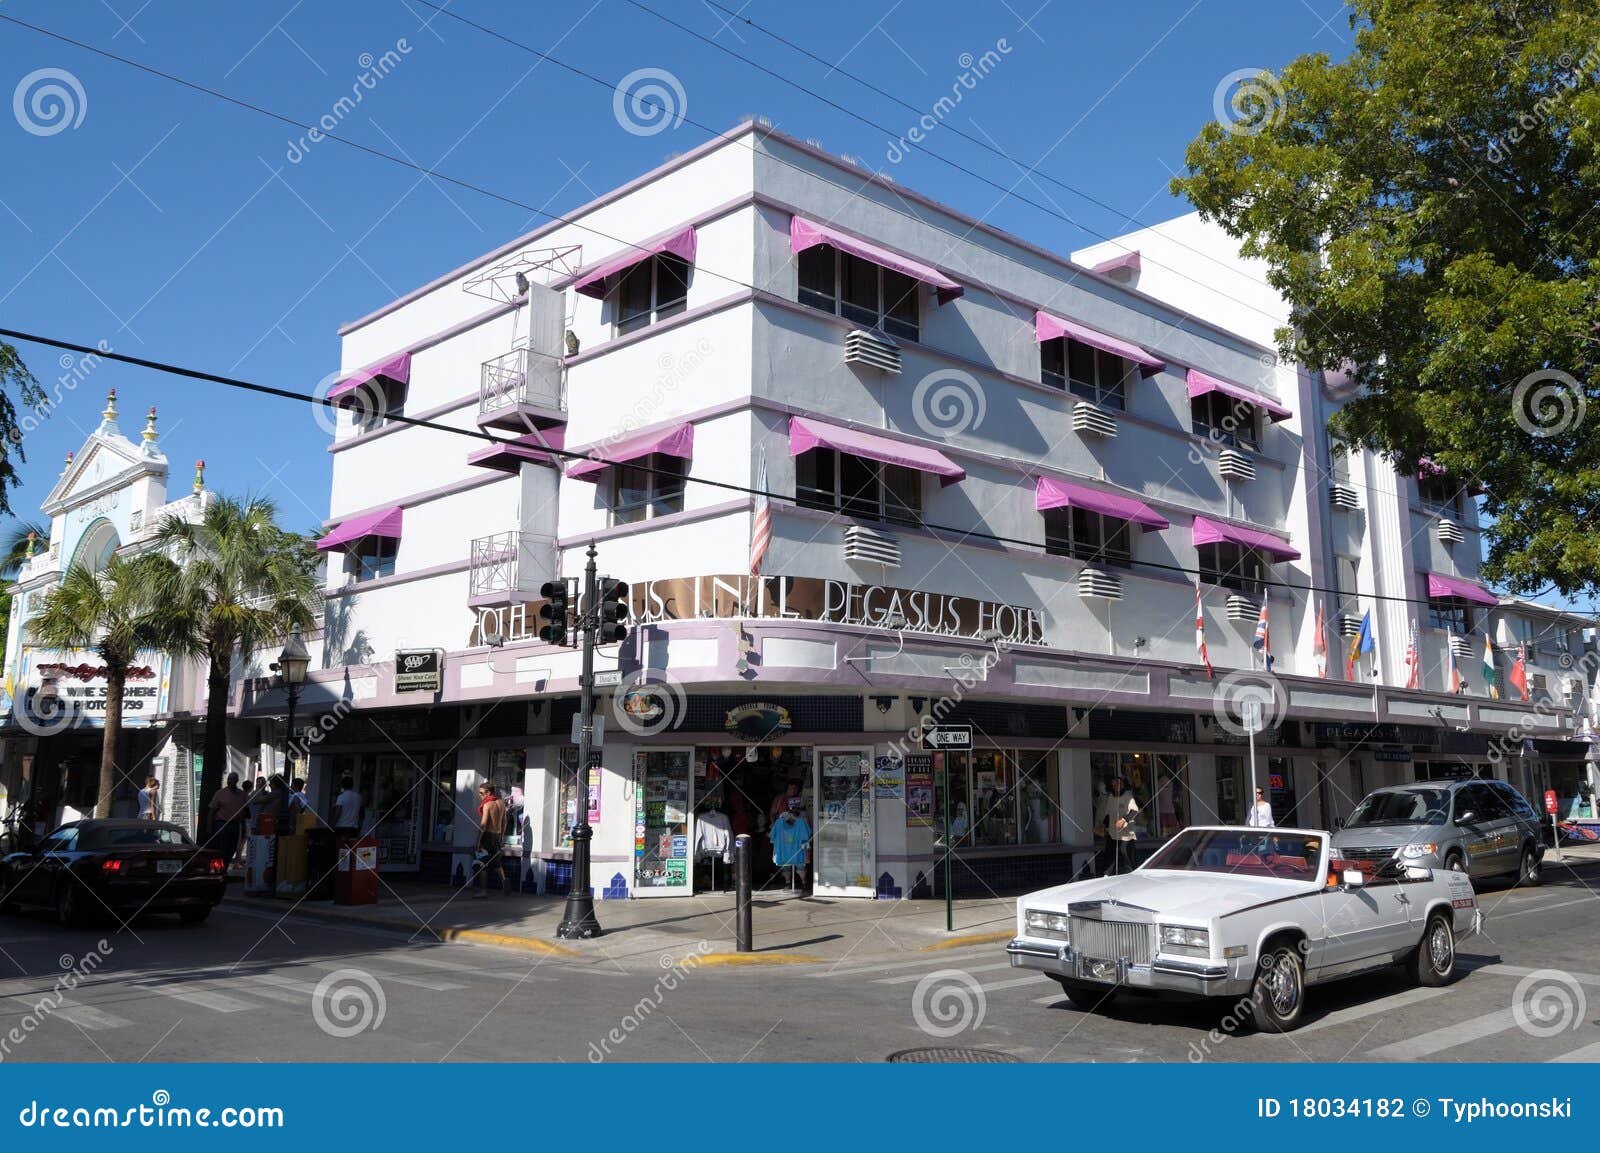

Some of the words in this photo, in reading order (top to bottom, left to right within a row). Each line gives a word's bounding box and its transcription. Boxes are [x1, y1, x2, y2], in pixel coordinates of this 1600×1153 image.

[824, 579, 961, 633] PEGASUS
[405, 655, 423, 668] AAA
[936, 733, 950, 743] ONE
[952, 732, 967, 743] WAY
